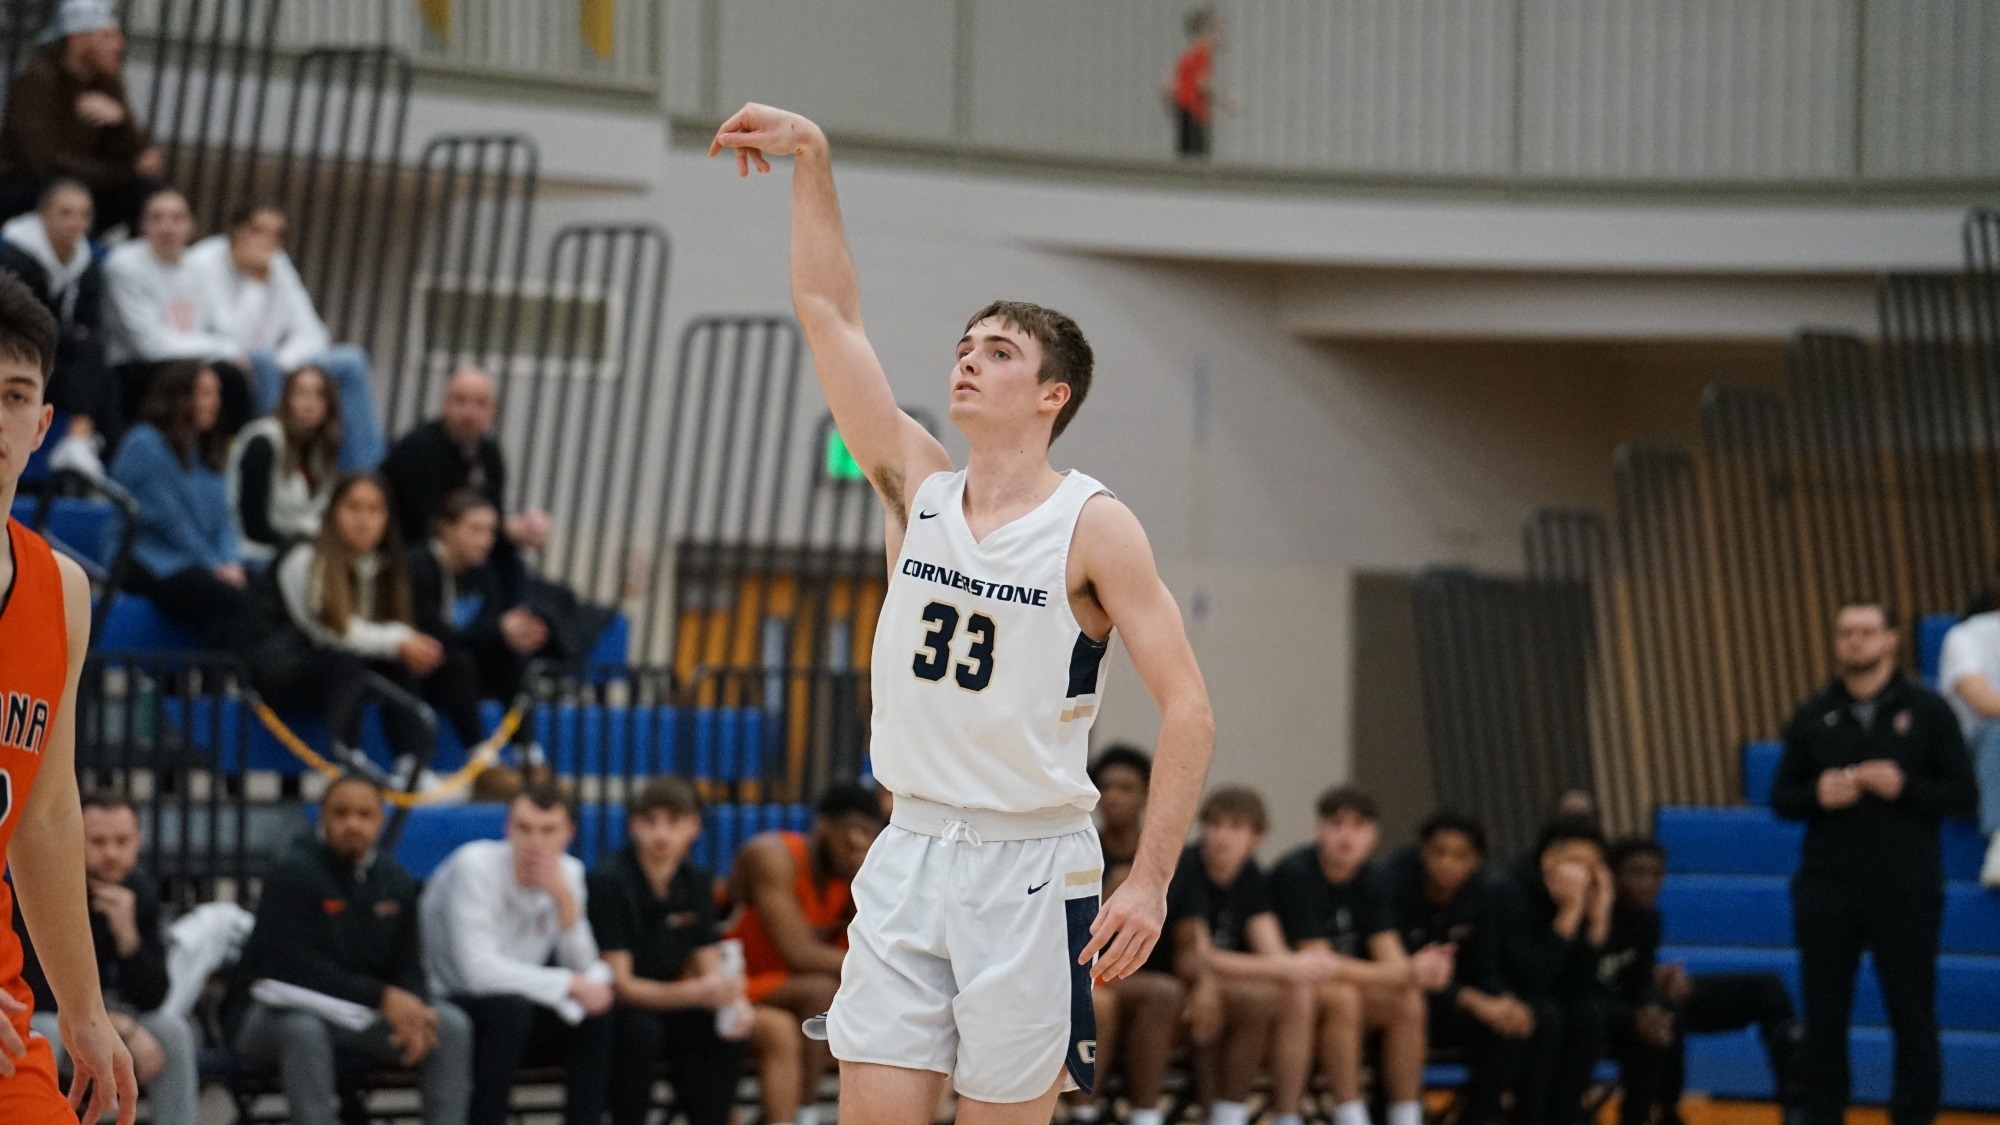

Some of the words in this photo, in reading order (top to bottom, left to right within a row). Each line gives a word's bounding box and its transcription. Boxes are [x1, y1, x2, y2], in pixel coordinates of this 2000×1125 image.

[902, 558, 1048, 607] CORNERSTONE
[912, 598, 997, 694] 33
[0, 691, 48, 754] NA
